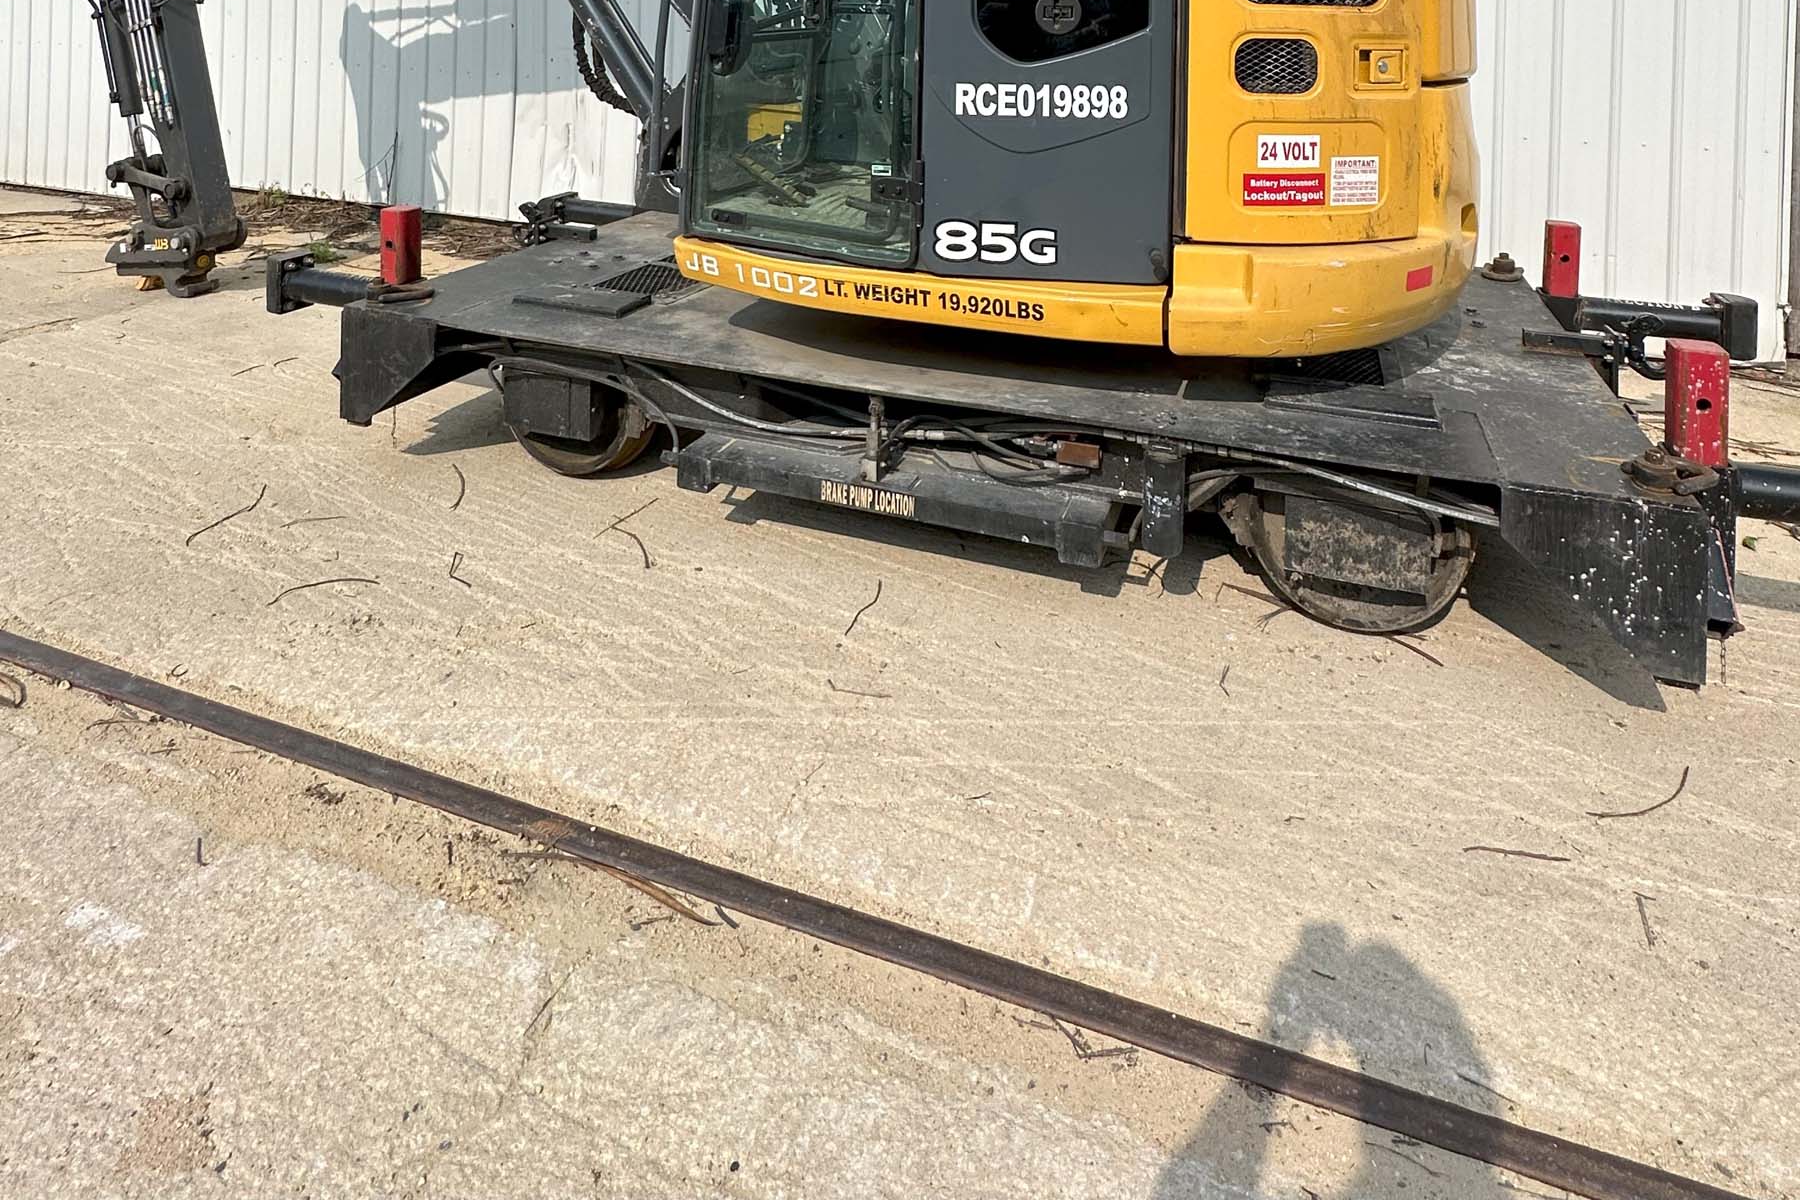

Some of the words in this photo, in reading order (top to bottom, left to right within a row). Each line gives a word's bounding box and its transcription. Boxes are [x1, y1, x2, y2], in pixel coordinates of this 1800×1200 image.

[955, 83, 1128, 119] RCE019898
[1261, 142, 1277, 160] 24
[1282, 142, 1317, 160] VOLT
[1244, 191, 1324, 202] Lockout/Tagout
[1250, 179, 1278, 188] Battery
[1280, 179, 1319, 187] Disconnect
[934, 220, 1057, 265] 85G
[685, 252, 719, 277] JB
[735, 263, 818, 298] 1002
[824, 279, 848, 298] LT.
[854, 282, 930, 307] WEIGHT
[938, 292, 1045, 322] 19,920LBS
[820, 480, 848, 505] BRAKE
[849, 485, 873, 509] PUMP
[874, 490, 915, 517] LOCATION
